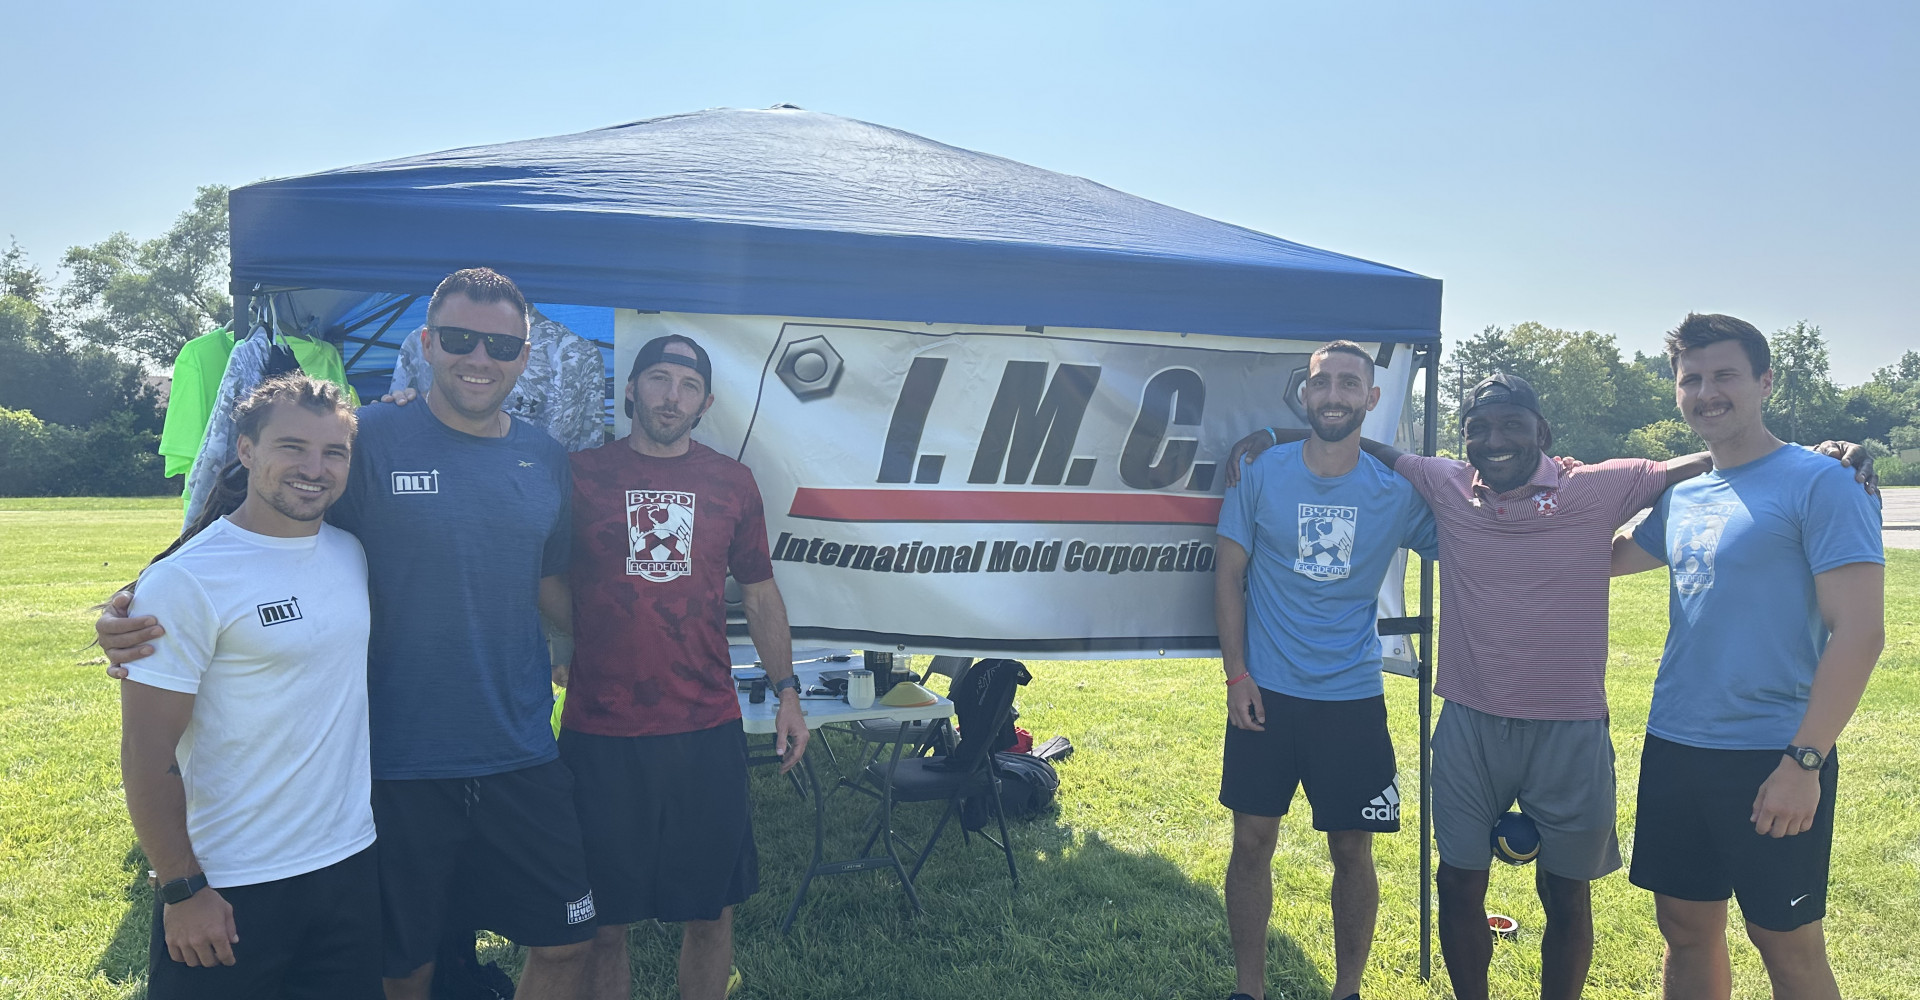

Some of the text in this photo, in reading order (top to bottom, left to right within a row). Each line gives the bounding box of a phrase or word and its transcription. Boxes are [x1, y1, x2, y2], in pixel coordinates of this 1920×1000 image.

[630, 493, 692, 506] BYRD
[1301, 506, 1354, 519] BYRD
[771, 531, 988, 574] International
[985, 538, 1063, 573] Mold
[630, 561, 688, 572] ACADEMY
[1298, 563, 1348, 575] ACADEMY
